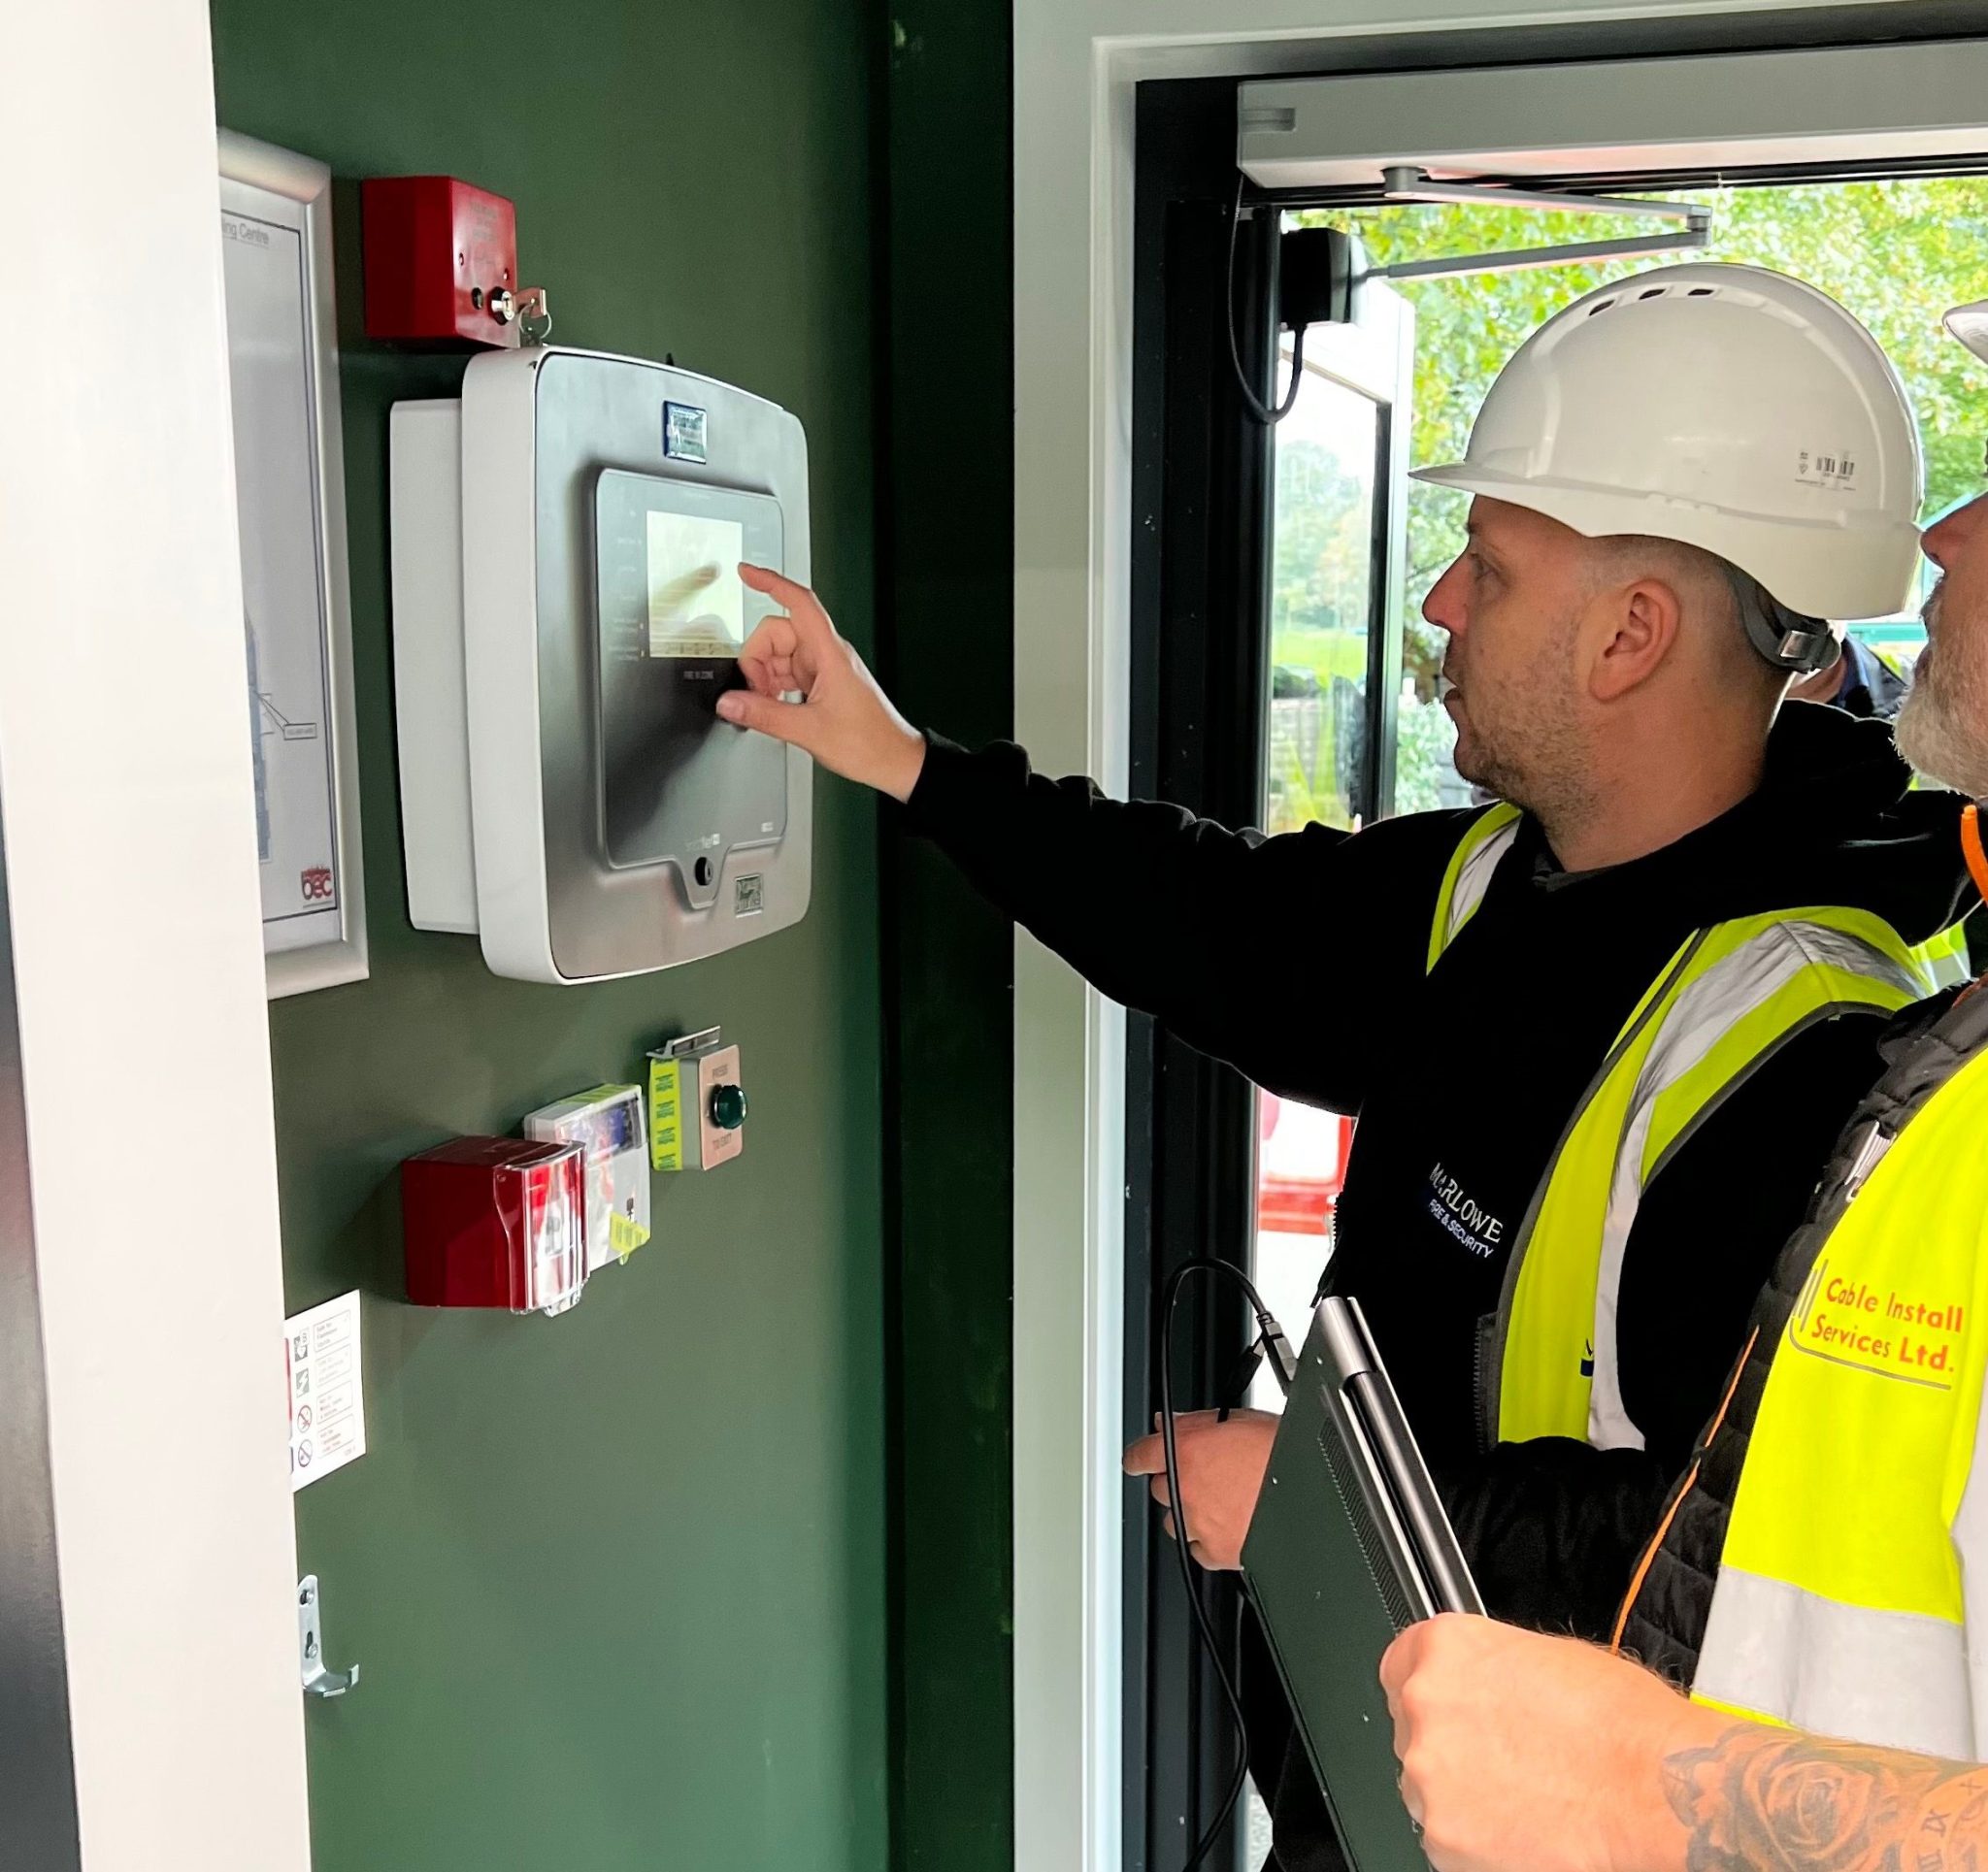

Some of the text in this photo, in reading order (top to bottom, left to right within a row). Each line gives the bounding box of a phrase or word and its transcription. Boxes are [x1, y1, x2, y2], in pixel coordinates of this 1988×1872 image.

[239, 222, 270, 246] Centre
[1429, 1162, 1504, 1243] MARLOWE
[1441, 1213, 1450, 1227] &
[1447, 1219, 1494, 1258] SECURITY
[1826, 1277, 1963, 1333] Cable Install
[1811, 1313, 1954, 1373] Services Ltd.
